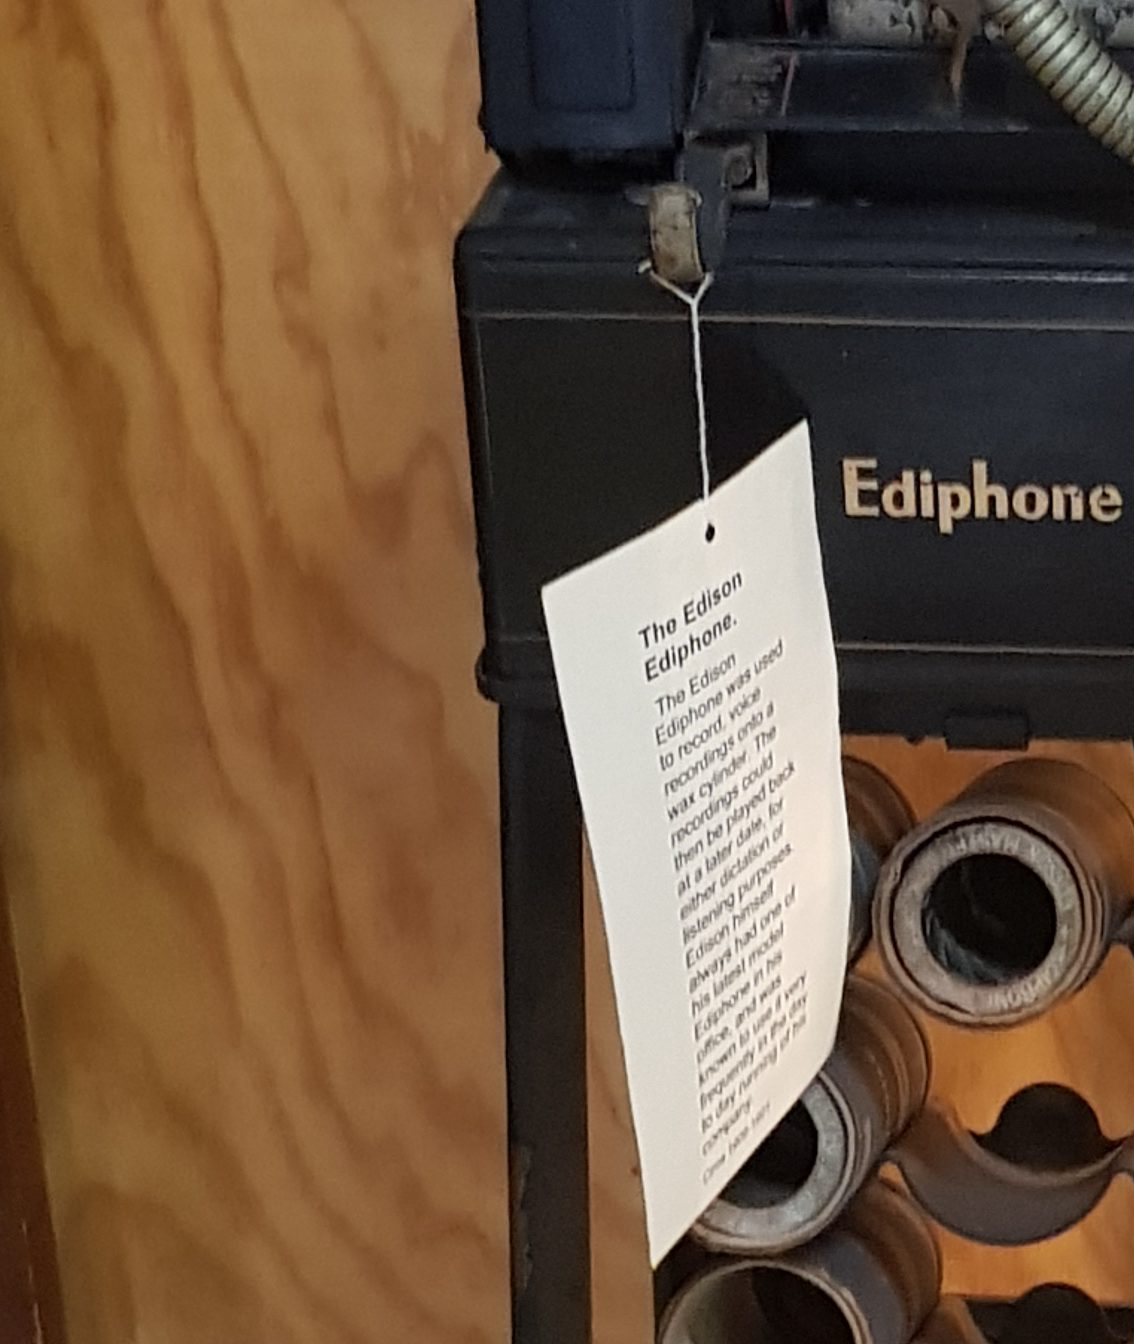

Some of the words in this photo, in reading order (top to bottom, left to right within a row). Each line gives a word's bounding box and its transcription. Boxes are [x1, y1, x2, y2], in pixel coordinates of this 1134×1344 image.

[842, 458, 1123, 535] Ediphone
[638, 618, 677, 649] The
[683, 571, 742, 625] Edison
[645, 612, 738, 682] Ediphone.
[655, 689, 685, 716] The
[689, 653, 736, 695] Edison
[655, 690, 723, 746] Ediphone
[726, 668, 751, 696] was
[754, 639, 783, 675] used
[659, 753, 674, 771] to
[729, 687, 761, 720] voice
[664, 735, 734, 796] recordings
[737, 711, 763, 741] onto
[767, 701, 774, 717] a
[667, 793, 695, 821] wax
[754, 725, 776, 751] The
[671, 785, 738, 848] recordings
[742, 751, 773, 791] could
[674, 839, 703, 873] then
[706, 823, 723, 846] be
[726, 783, 766, 836] played
[768, 760, 795, 794] back
[678, 874, 690, 898] at
[694, 868, 703, 883] a
[705, 841, 732, 874] later
[768, 797, 784, 820] for
[680, 881, 716, 921] either
[720, 836, 770, 888] dictation
[683, 892, 735, 945] listening
[686, 924, 730, 969] Edison
[732, 877, 774, 930] himself
[690, 947, 732, 994] always
[735, 920, 757, 954] had
[760, 902, 782, 930] one
[785, 884, 796, 908] of
[692, 992, 711, 1019] his
[713, 957, 746, 998] latest
[749, 920, 784, 968] model
[695, 980, 750, 1043] Ediphone
[766, 949, 782, 975] his
[735, 996, 757, 1030] and
[760, 975, 781, 1003] was
